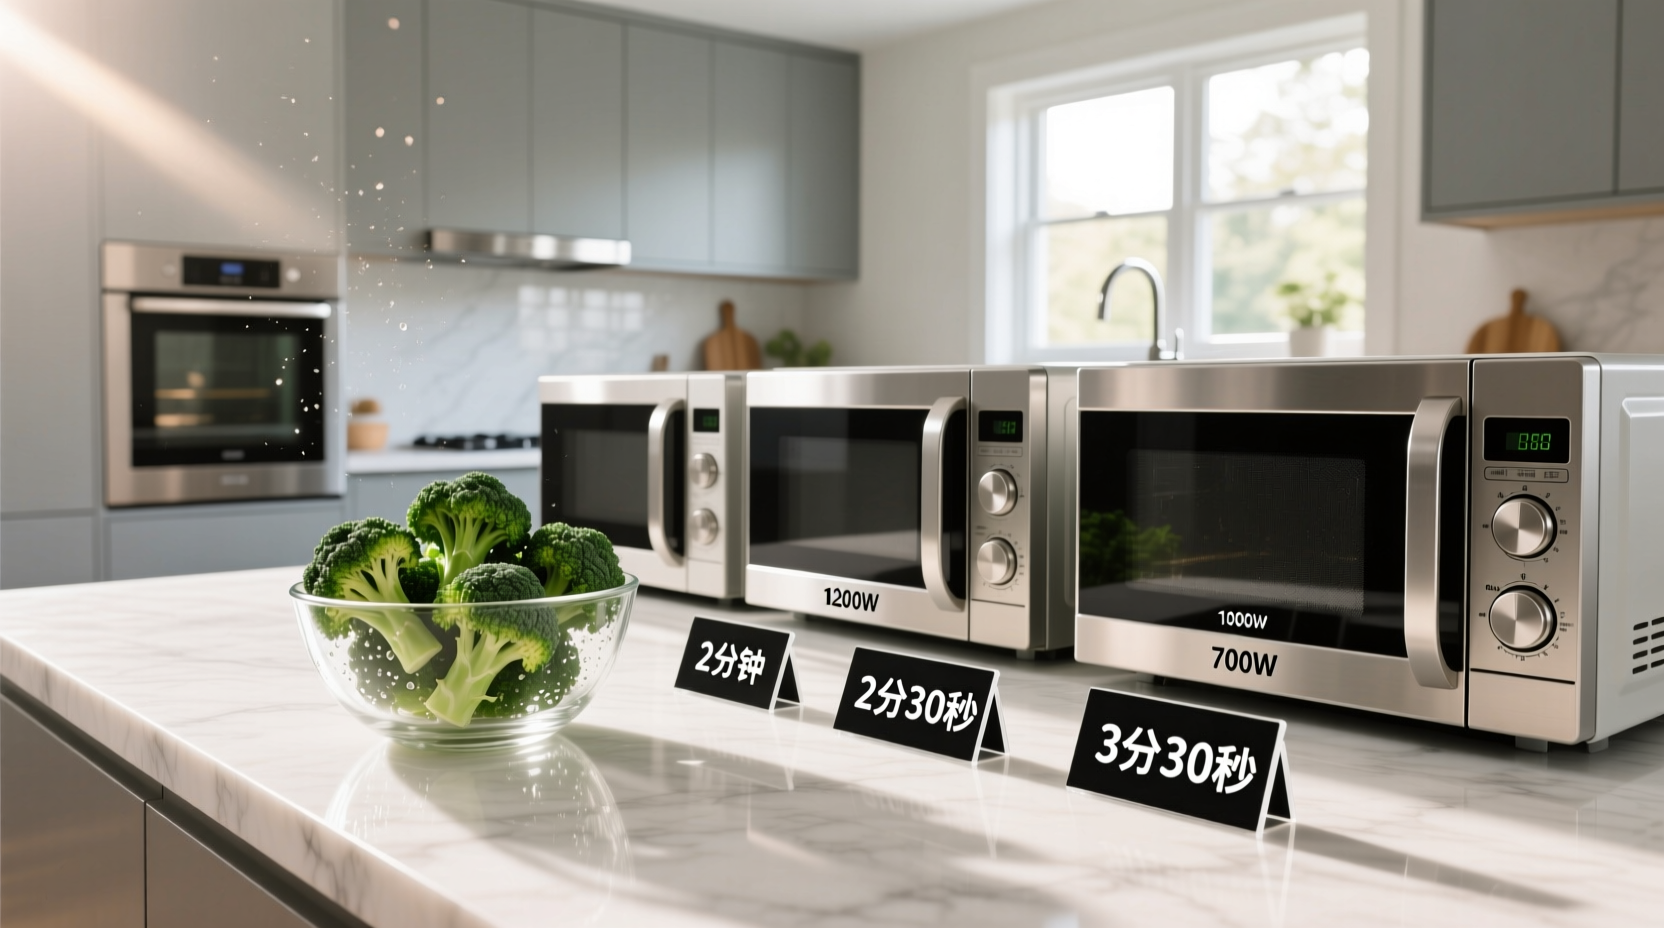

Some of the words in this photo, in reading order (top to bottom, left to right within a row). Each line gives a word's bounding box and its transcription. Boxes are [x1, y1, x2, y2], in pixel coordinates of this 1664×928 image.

[823, 587, 880, 613] 1200W
[1217, 609, 1269, 631] 1000W
[694, 640, 766, 686] 2分钟
[1210, 645, 1279, 678] 700W
[853, 675, 979, 734] 2分30秒
[1094, 722, 1257, 795] 3分30秒
